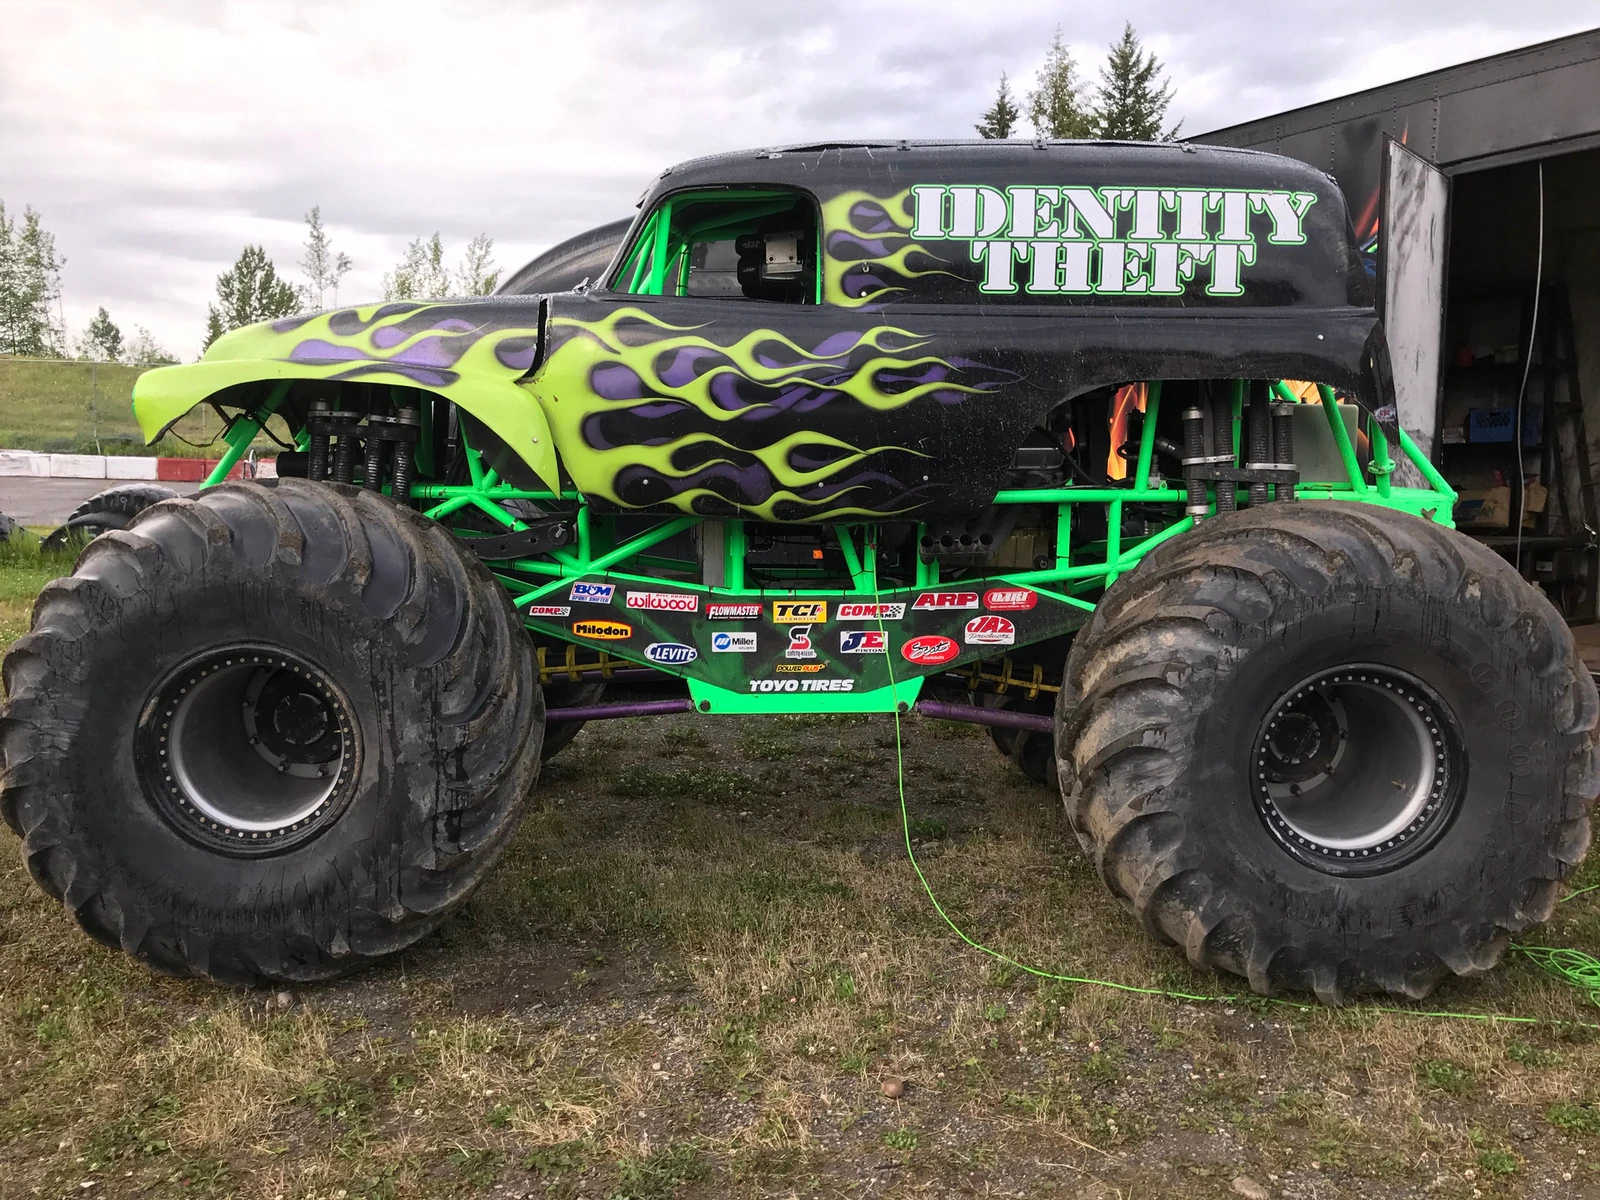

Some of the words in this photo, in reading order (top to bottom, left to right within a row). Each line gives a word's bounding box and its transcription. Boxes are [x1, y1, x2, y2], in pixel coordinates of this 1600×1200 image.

[910, 184, 1318, 244] IDENTITY
[970, 240, 1257, 295] THEFT
[574, 584, 612, 596] B&M
[627, 593, 698, 611] wilwood
[914, 593, 978, 607] ARP
[708, 605, 760, 620] FLOWMASTER
[776, 604, 821, 617] TCI
[840, 605, 890, 616] COMP
[576, 624, 629, 636] Milodon
[966, 616, 1014, 634] JAZ
[731, 637, 755, 646] Miller
[841, 632, 885, 652] JE
[749, 679, 799, 692] TOYO
[800, 679, 855, 692] TIRES
